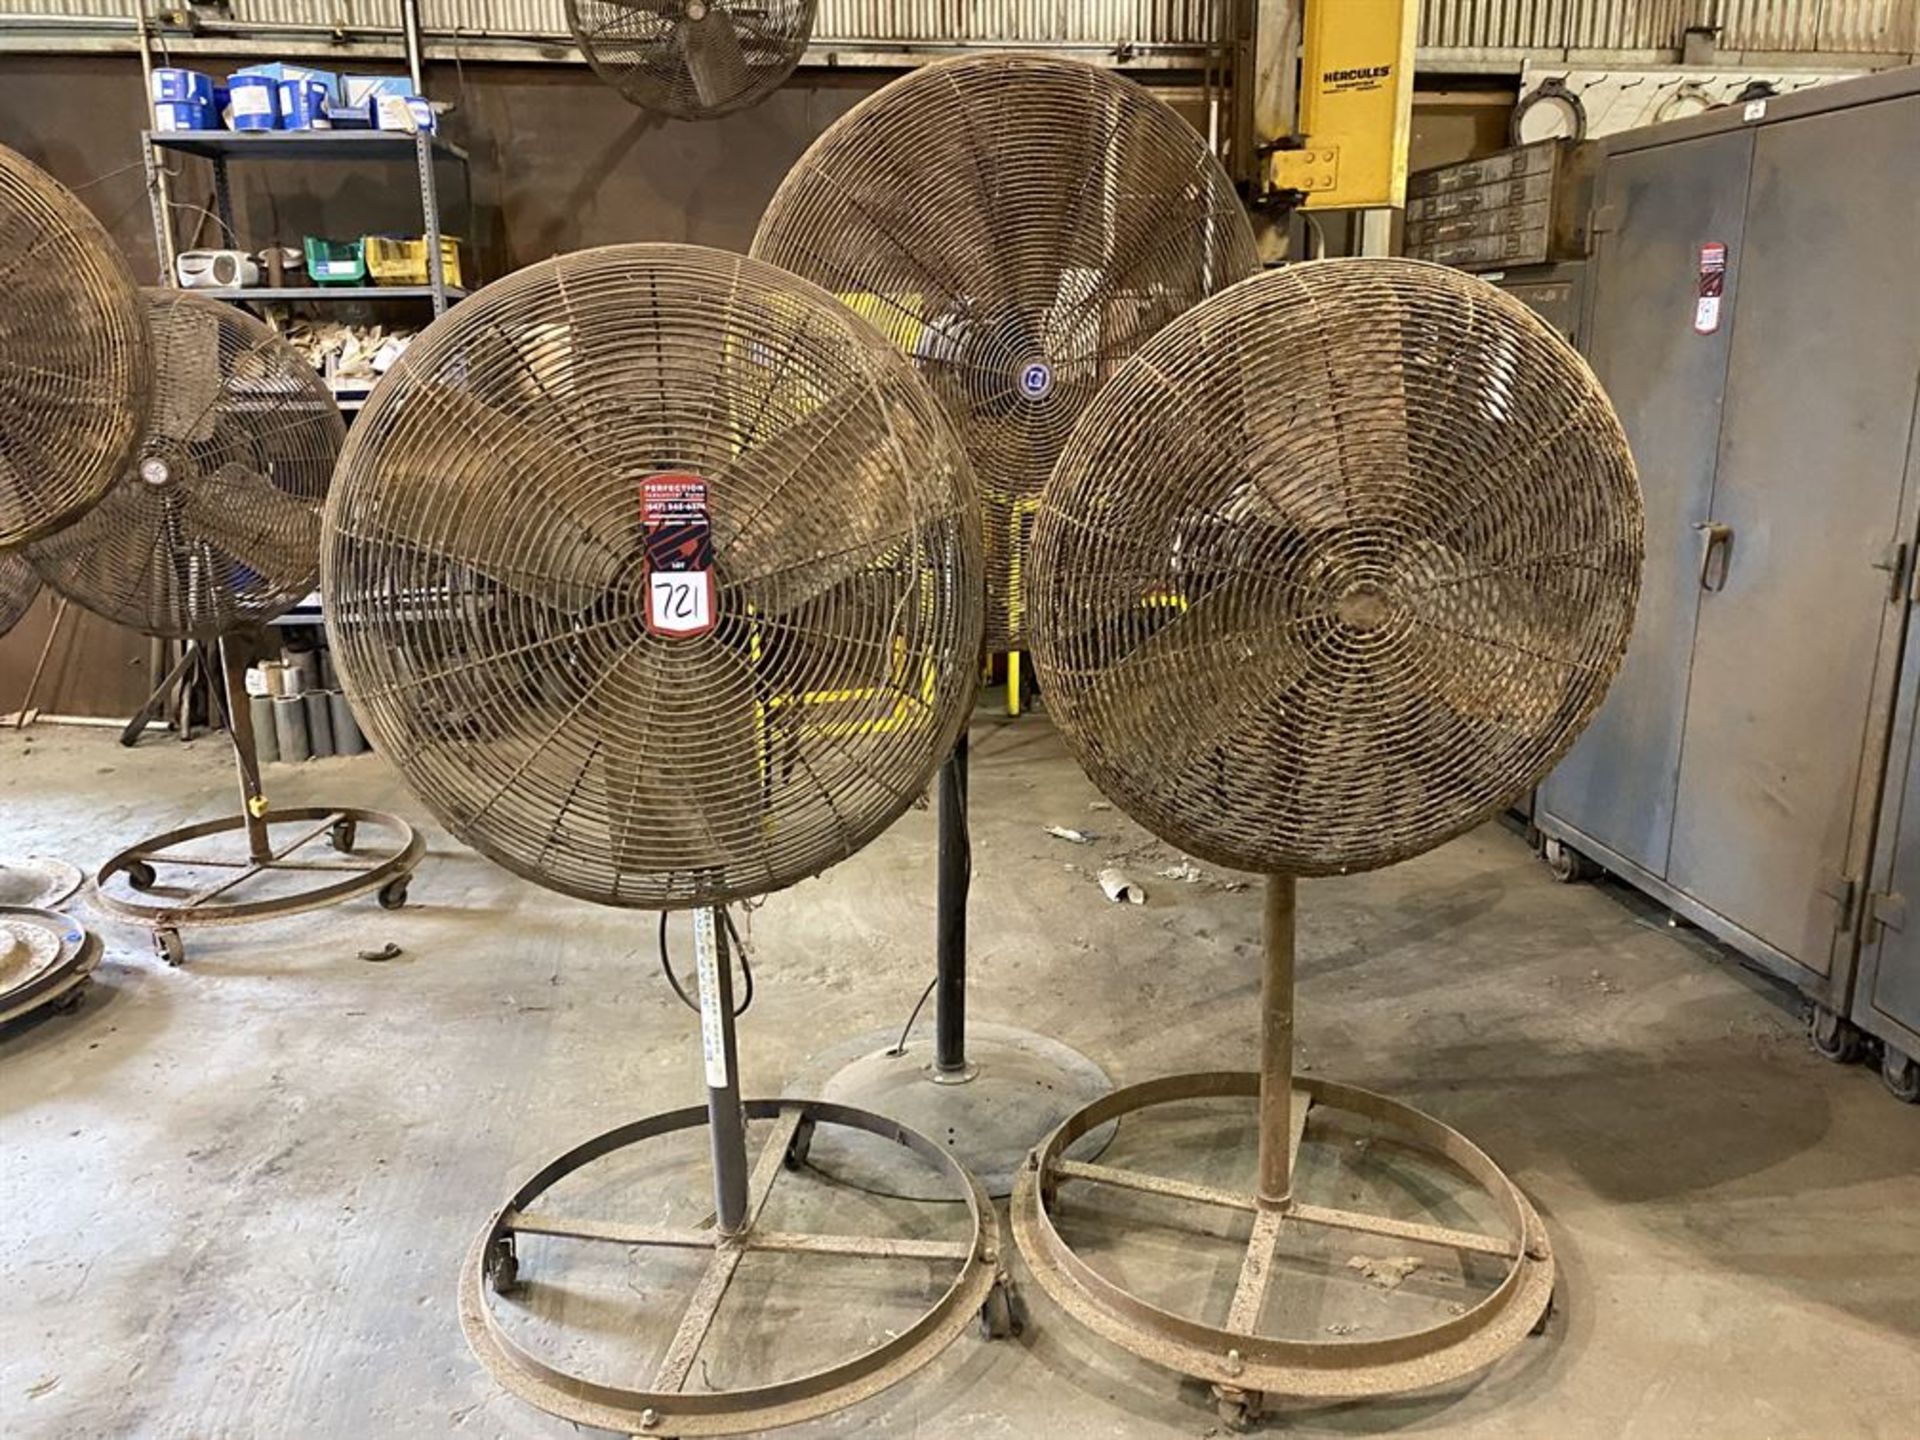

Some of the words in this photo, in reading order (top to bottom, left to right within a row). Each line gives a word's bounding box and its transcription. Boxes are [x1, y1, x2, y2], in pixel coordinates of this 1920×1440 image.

[1323, 66, 1390, 83] HERCULES
[645, 484, 704, 492] PERFECTION
[655, 583, 698, 619] 721
